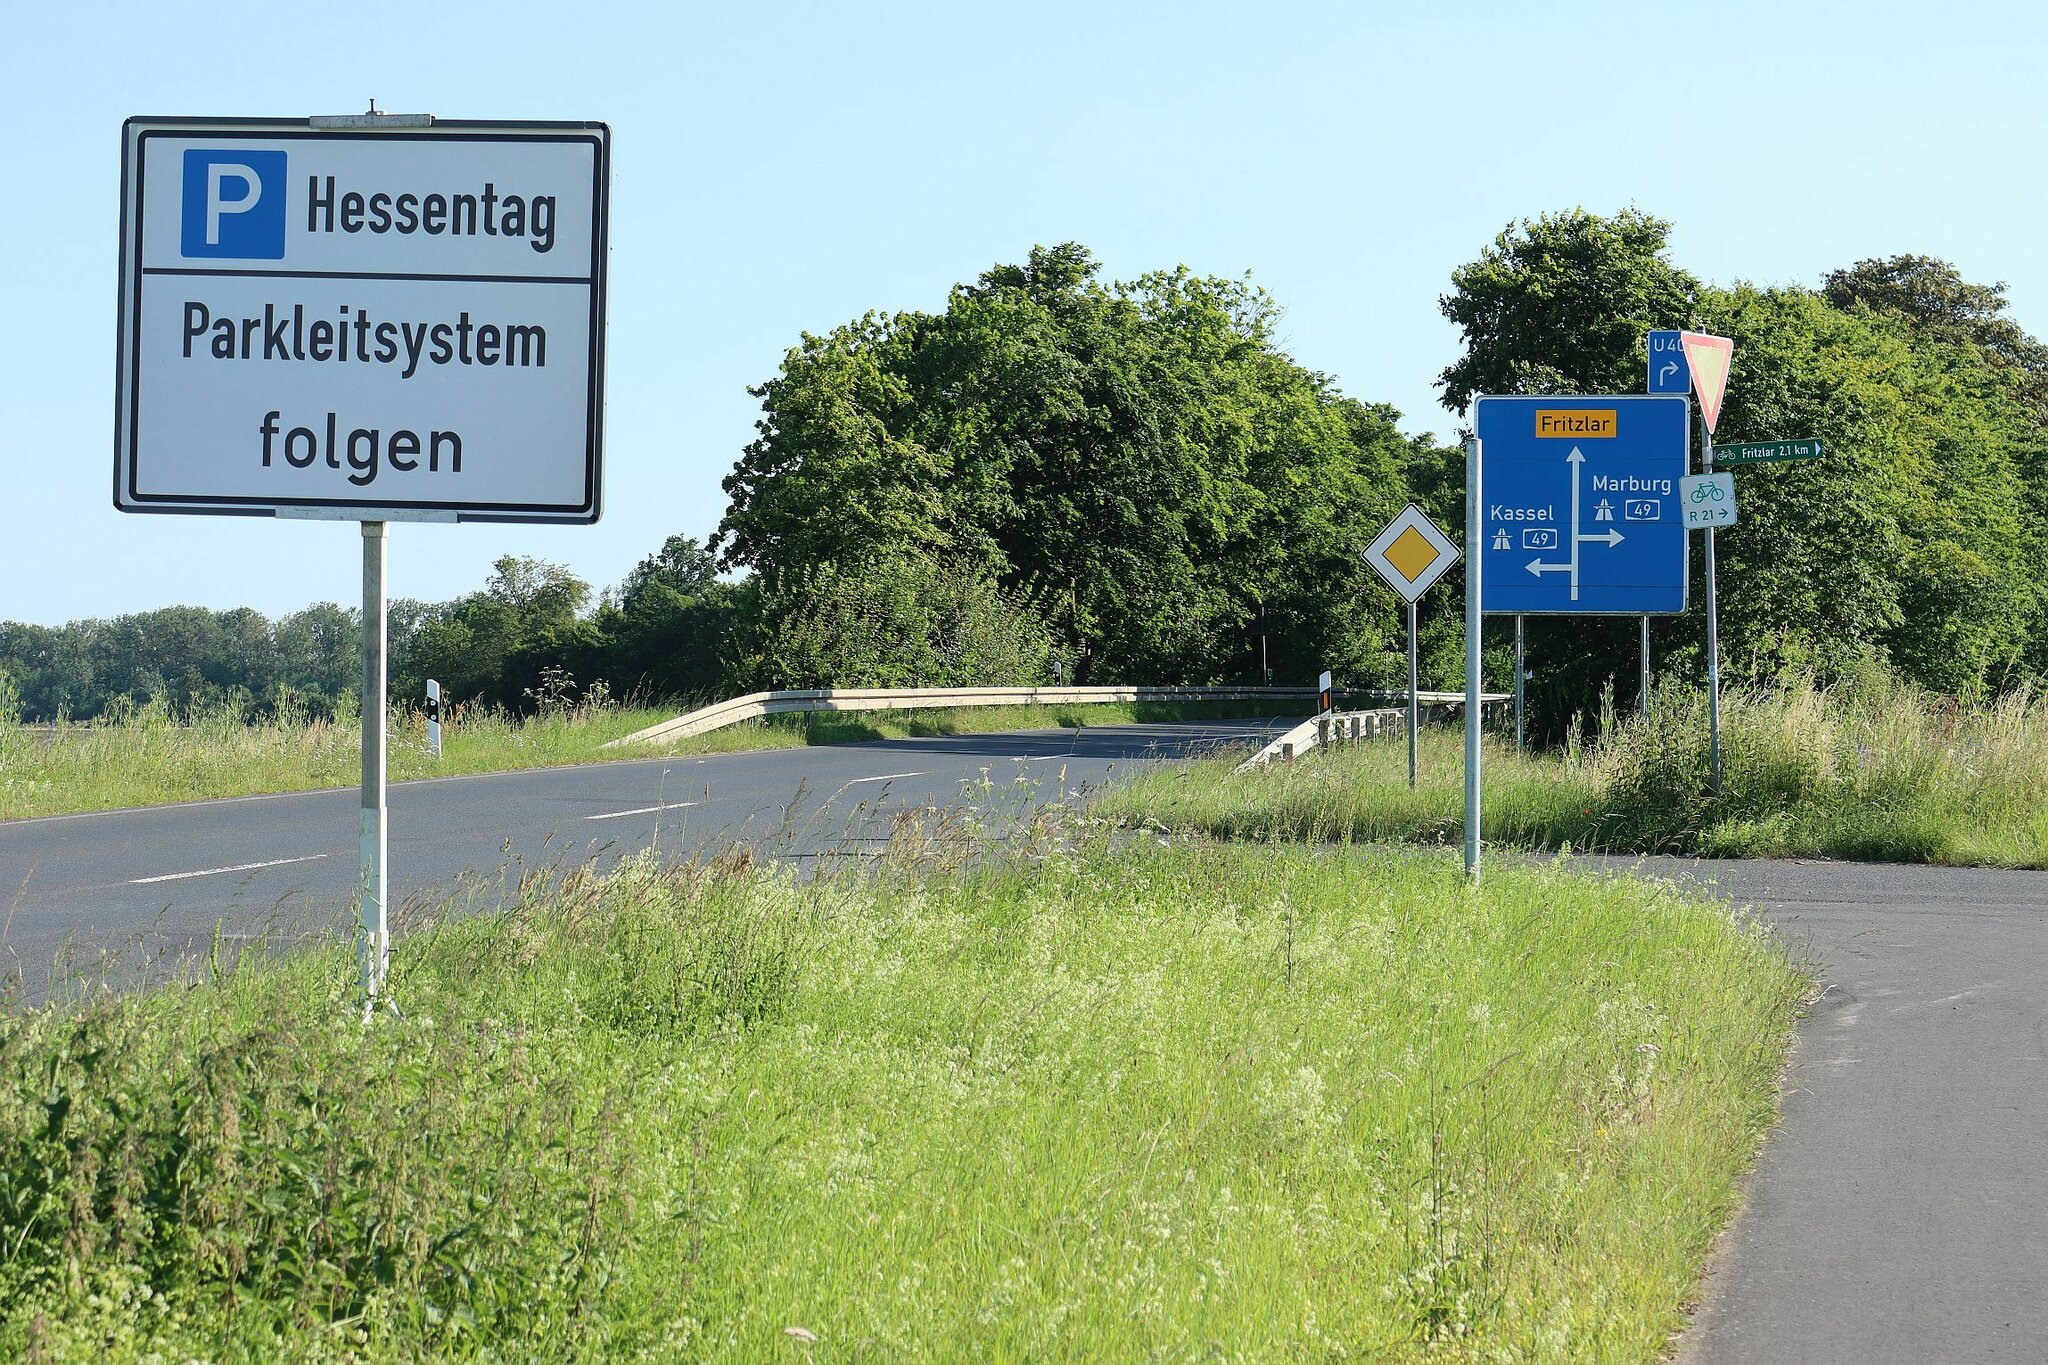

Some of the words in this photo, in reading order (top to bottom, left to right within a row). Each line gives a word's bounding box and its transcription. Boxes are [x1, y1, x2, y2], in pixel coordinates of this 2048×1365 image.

[206, 163, 262, 245] P
[308, 175, 556, 254] Hessentag
[183, 301, 547, 380] Parkleitsystem
[1654, 338, 1664, 352] U
[1541, 416, 1610, 431] Fritzlar
[259, 411, 463, 487] folgen
[1742, 447, 1775, 459] Fritzlar
[1795, 444, 1809, 455] km
[1593, 475, 1671, 495] Marburg
[1491, 505, 1554, 521] Kassel
[1634, 504, 1651, 516] 49
[1690, 511, 1697, 522] R
[1702, 510, 1714, 521] 21
[1532, 533, 1549, 546] 49
